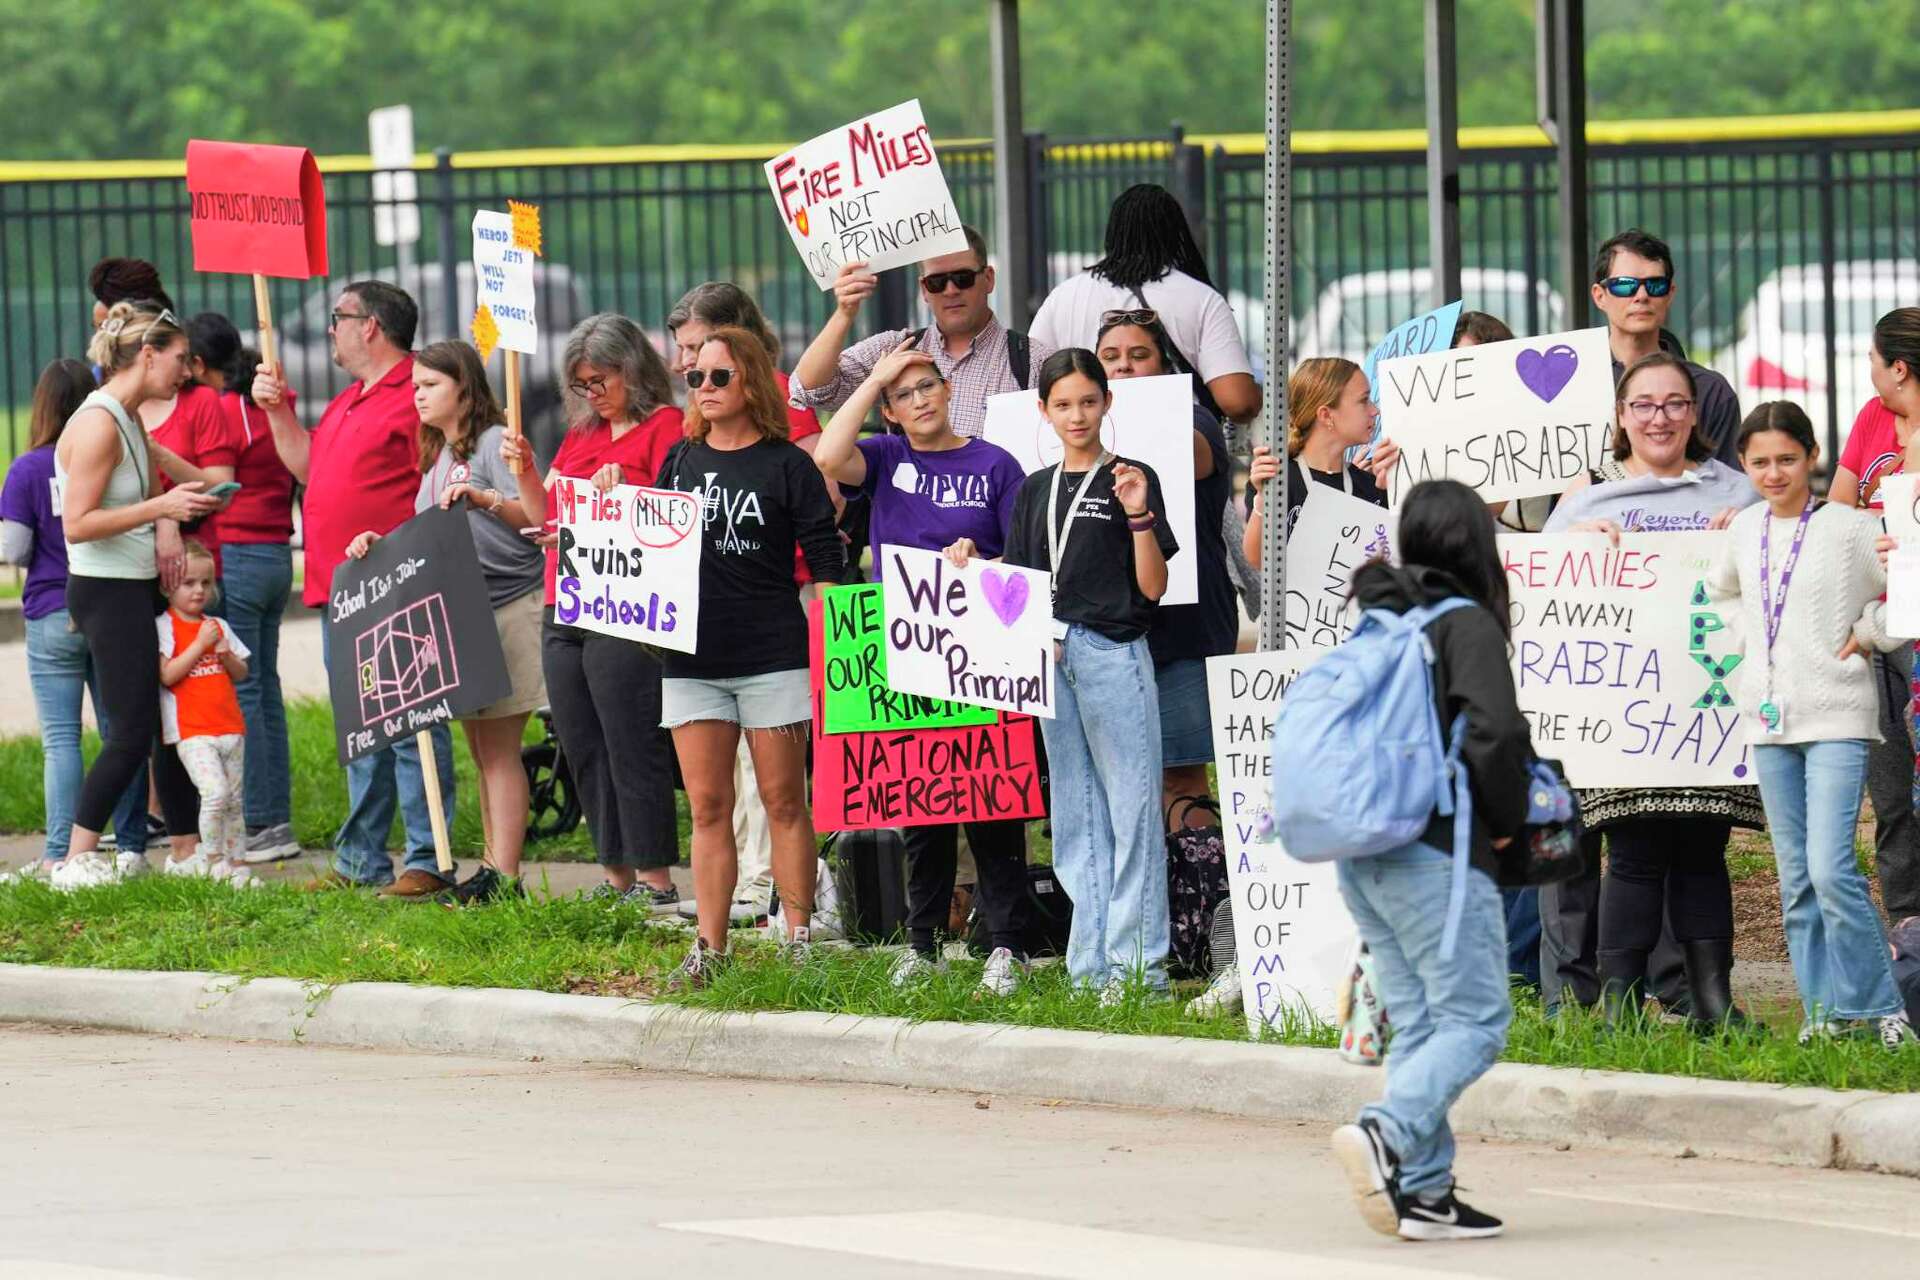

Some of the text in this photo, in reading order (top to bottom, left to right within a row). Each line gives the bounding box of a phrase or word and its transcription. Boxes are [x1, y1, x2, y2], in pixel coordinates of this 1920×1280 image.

[189, 191, 208, 219] NO
[253, 195, 268, 223] NO
[272, 198, 304, 225] BOND
[829, 191, 880, 234] NOT
[477, 227, 508, 242] HEROD
[809, 203, 960, 277] OUR PRINCIPAL
[482, 264, 505, 279] WILL
[503, 250, 523, 264] JETS
[486, 280, 504, 292] NOT
[1389, 357, 1475, 407] WE
[637, 497, 689, 527] MILES
[715, 540, 760, 550] BAND
[894, 554, 968, 617] We
[1312, 525, 1361, 646] DENTS
[1504, 551, 1548, 587] KE
[333, 580, 366, 623] School
[828, 590, 880, 641] WE
[1539, 599, 1633, 633] AWAY!
[890, 618, 953, 655] our
[827, 644, 885, 691] OUR
[945, 645, 1048, 711] Principal
[1520, 640, 1661, 692] RABIA
[1231, 669, 1300, 701] DON'
[347, 729, 376, 758] Free
[383, 716, 402, 737] Our
[843, 727, 1031, 784] NATIONAL
[1226, 753, 1272, 778] THE
[843, 772, 1033, 825] EMERGENCY
[1247, 882, 1310, 911] OUT
[1254, 922, 1291, 949] OF
